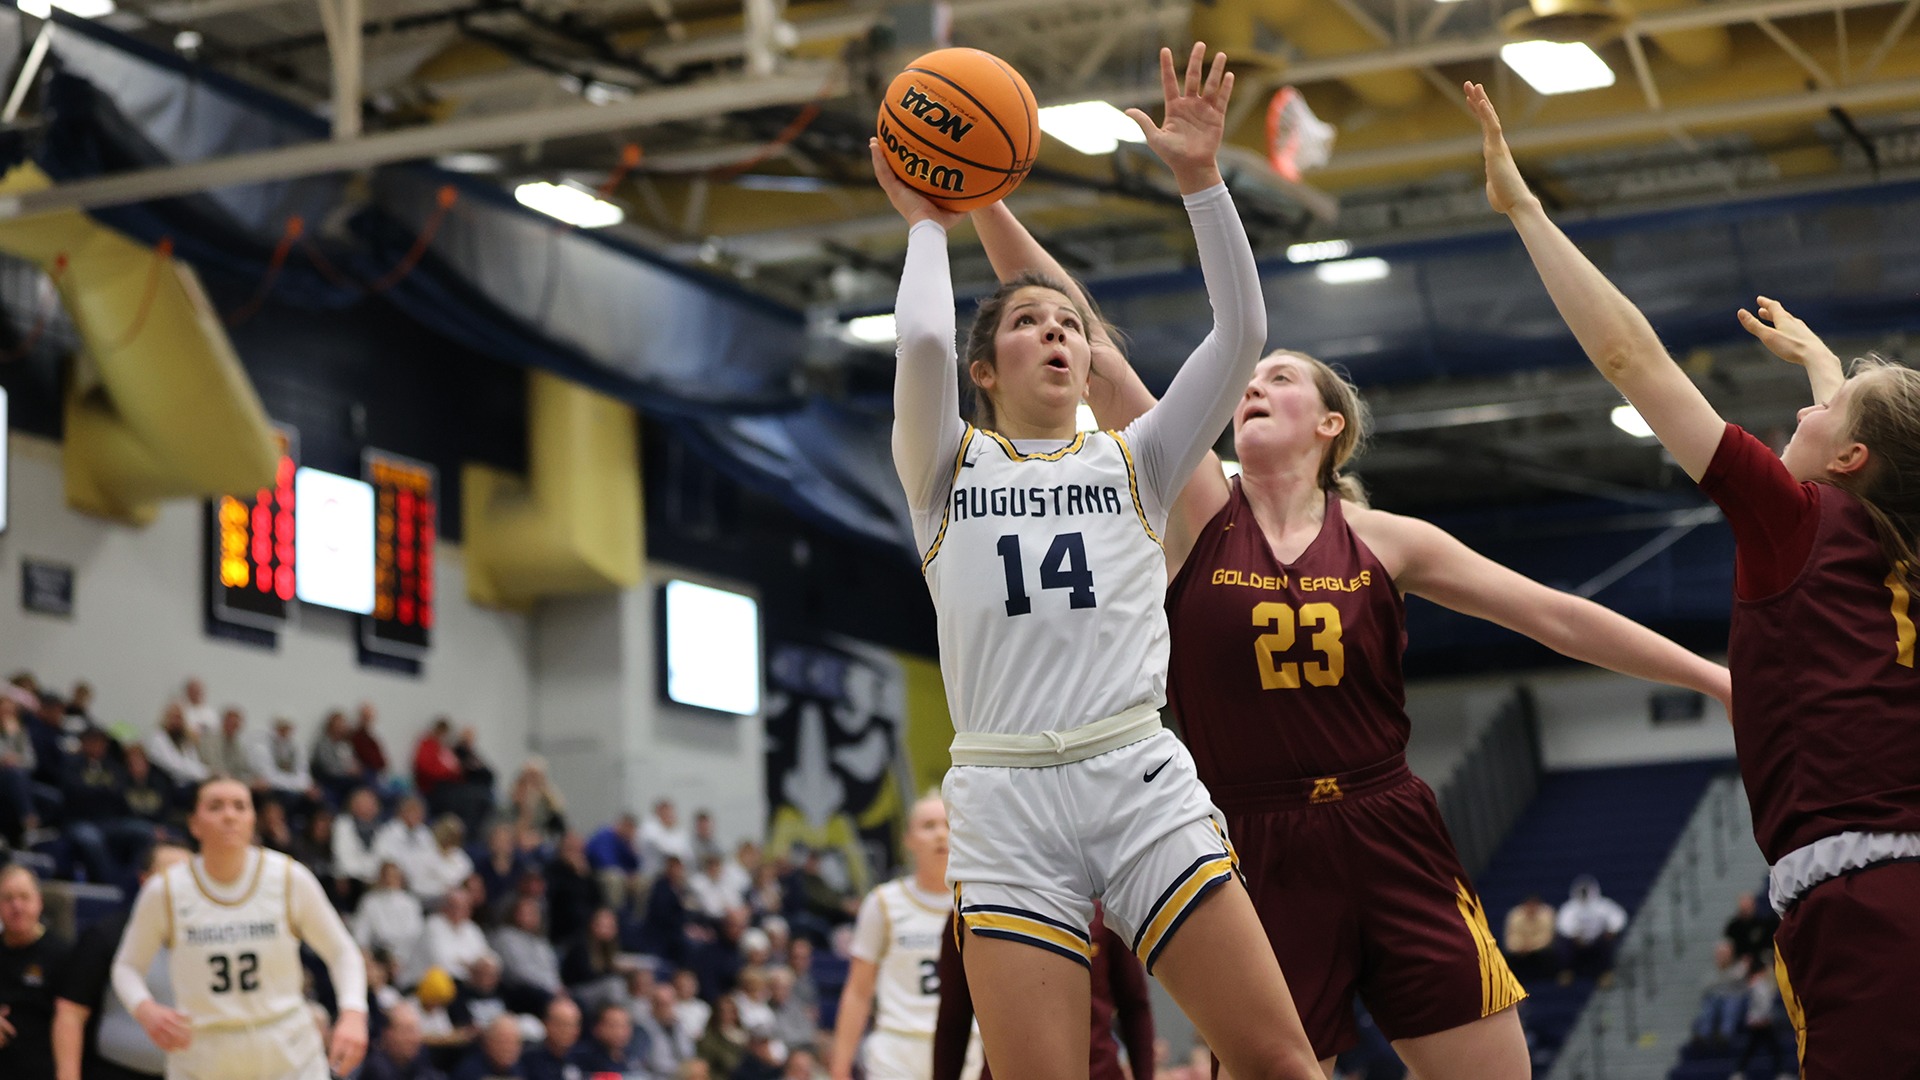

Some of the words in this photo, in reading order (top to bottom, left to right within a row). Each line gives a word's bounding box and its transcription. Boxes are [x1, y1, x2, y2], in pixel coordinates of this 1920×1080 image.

[900, 85, 973, 143] NCAA
[880, 118, 964, 192] Wilson
[954, 485, 1121, 522] AUGUSTANA
[996, 531, 1097, 617] 14
[1211, 568, 1289, 591] GOLDEN
[1299, 570, 1371, 592] EAGLES
[1252, 601, 1344, 690] 23
[208, 952, 260, 993] 32
